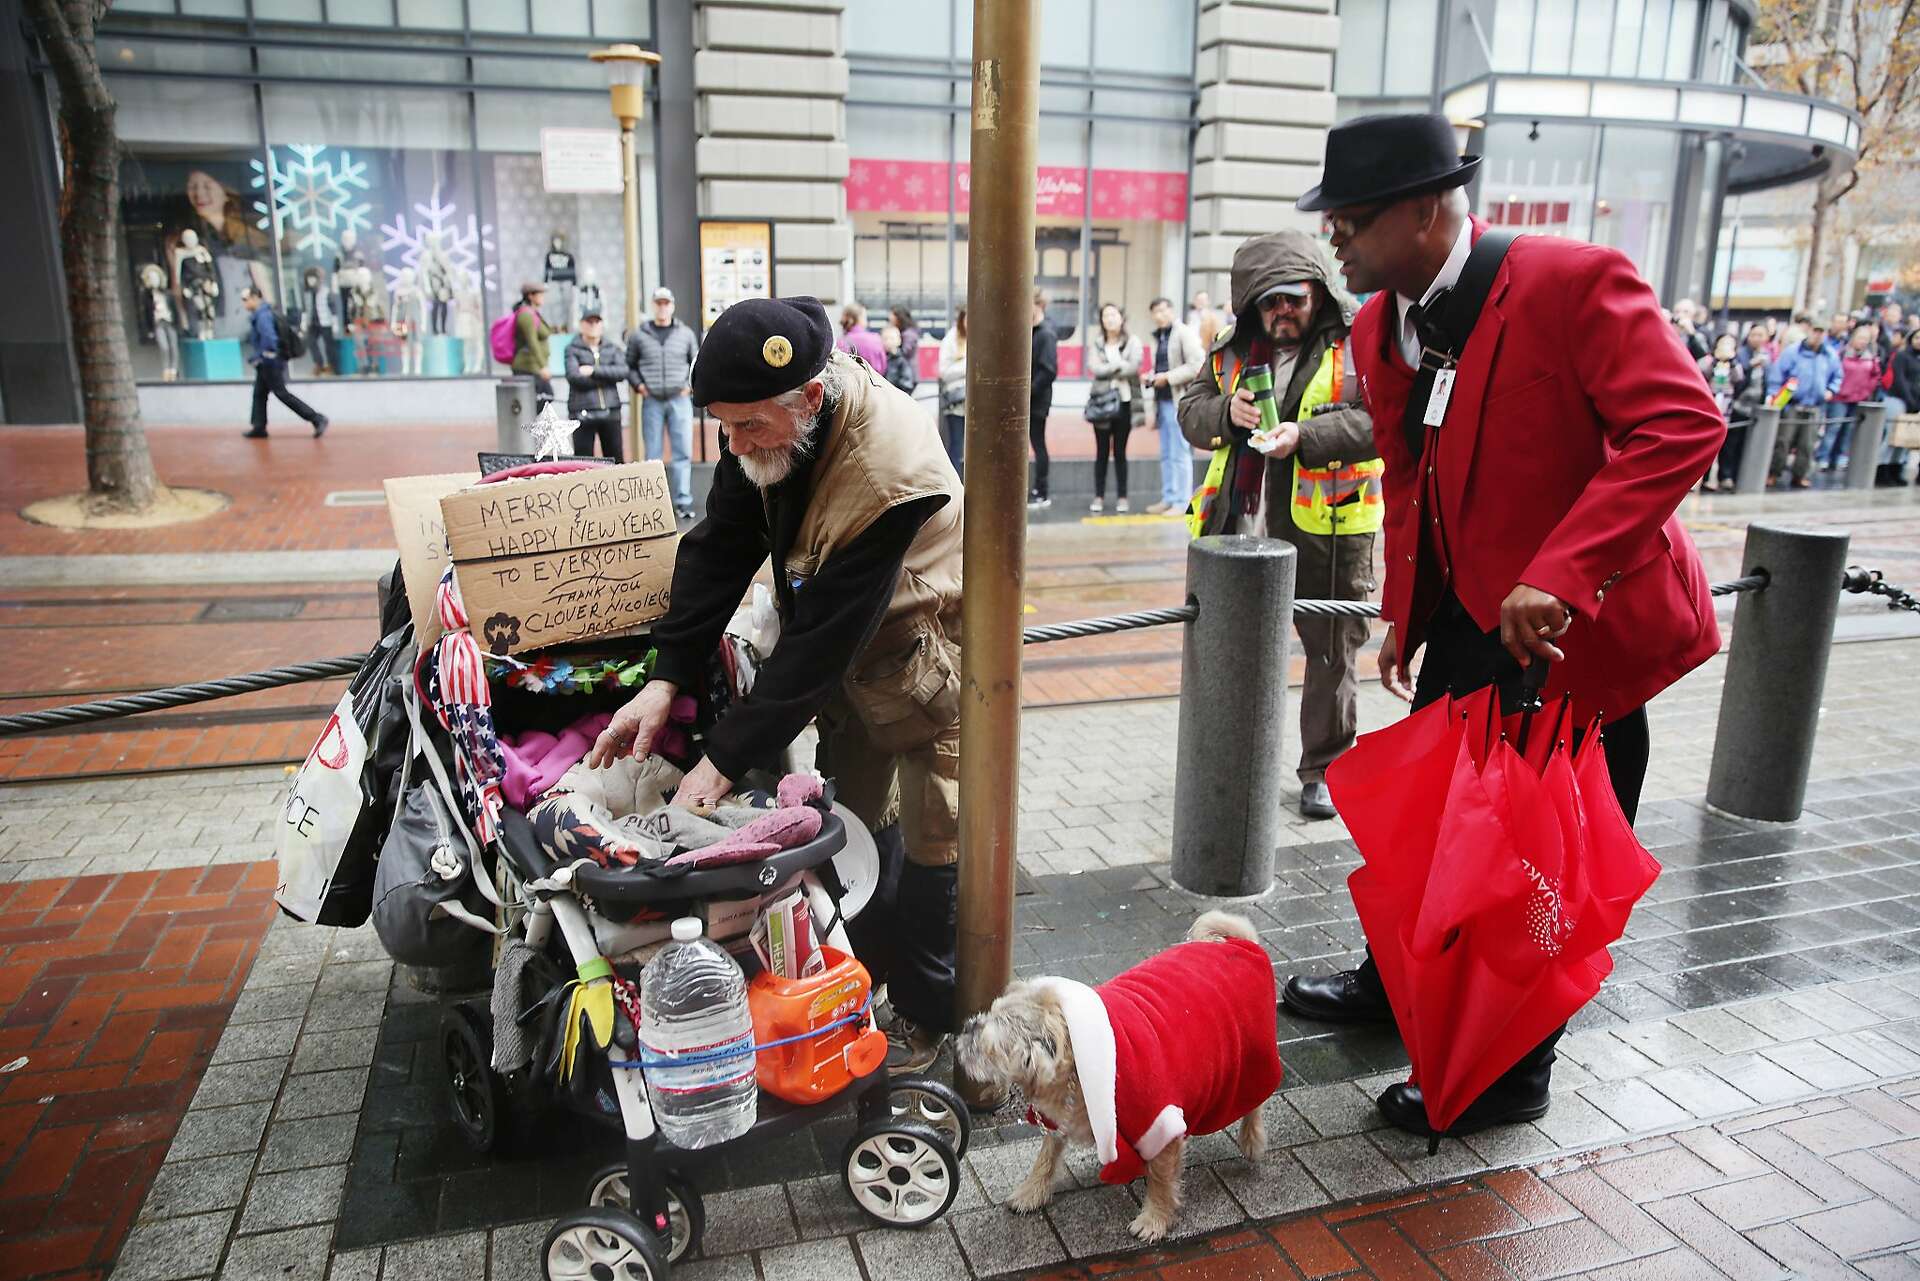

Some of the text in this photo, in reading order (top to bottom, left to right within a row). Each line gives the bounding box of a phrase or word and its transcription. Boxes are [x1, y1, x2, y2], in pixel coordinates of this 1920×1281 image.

[480, 476, 666, 529] MERRY CHRISTMAS
[487, 508, 666, 558] HAPPY NEW YEAR
[492, 543, 651, 588] TO EVERYONE
[543, 582, 641, 604] THANK YOU
[566, 617, 617, 635] JACK
